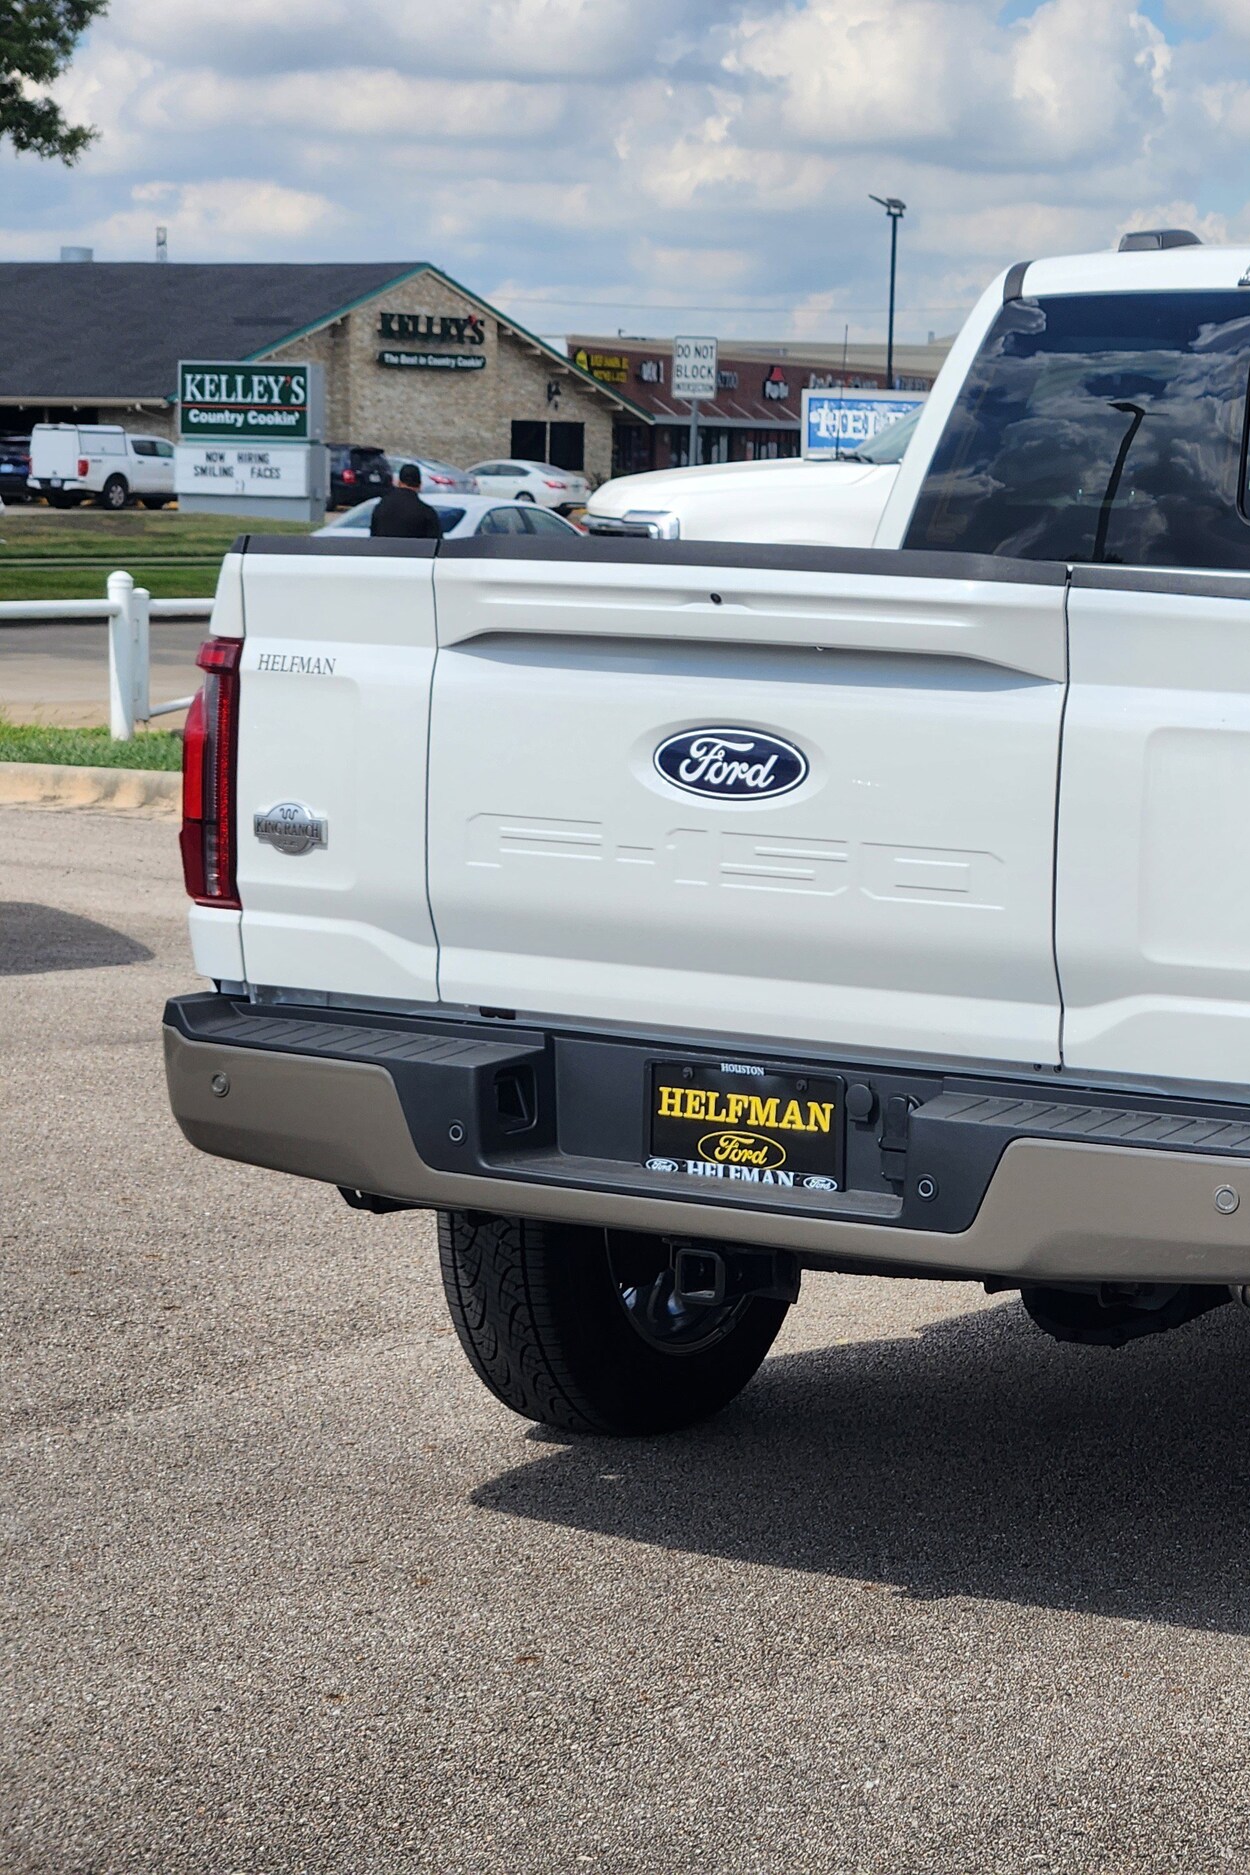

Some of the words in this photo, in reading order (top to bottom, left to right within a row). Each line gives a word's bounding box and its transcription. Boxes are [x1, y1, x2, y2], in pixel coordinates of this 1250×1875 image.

[377, 313, 485, 345] KELLEY'S
[676, 344, 691, 359] DO
[694, 345, 714, 360] NOT
[676, 364, 714, 379] BLOCK
[184, 373, 305, 405] KELLEY'S
[188, 408, 245, 427] Country
[247, 411, 300, 426] Cookin'
[205, 451, 225, 463] NOW
[237, 452, 270, 465] HIRING
[193, 465, 234, 478] SMILING
[250, 467, 281, 479] FACES
[257, 653, 337, 675] HELFMAN
[678, 737, 779, 789] Ford
[256, 818, 282, 834] KING
[284, 822, 319, 838] RANCH
[465, 811, 1005, 912] F-150
[720, 1062, 765, 1077] HOUSTON
[657, 1086, 835, 1133] HELFMAN
[713, 1134, 769, 1166] Ford
[685, 1160, 795, 1188] HELFMAN
